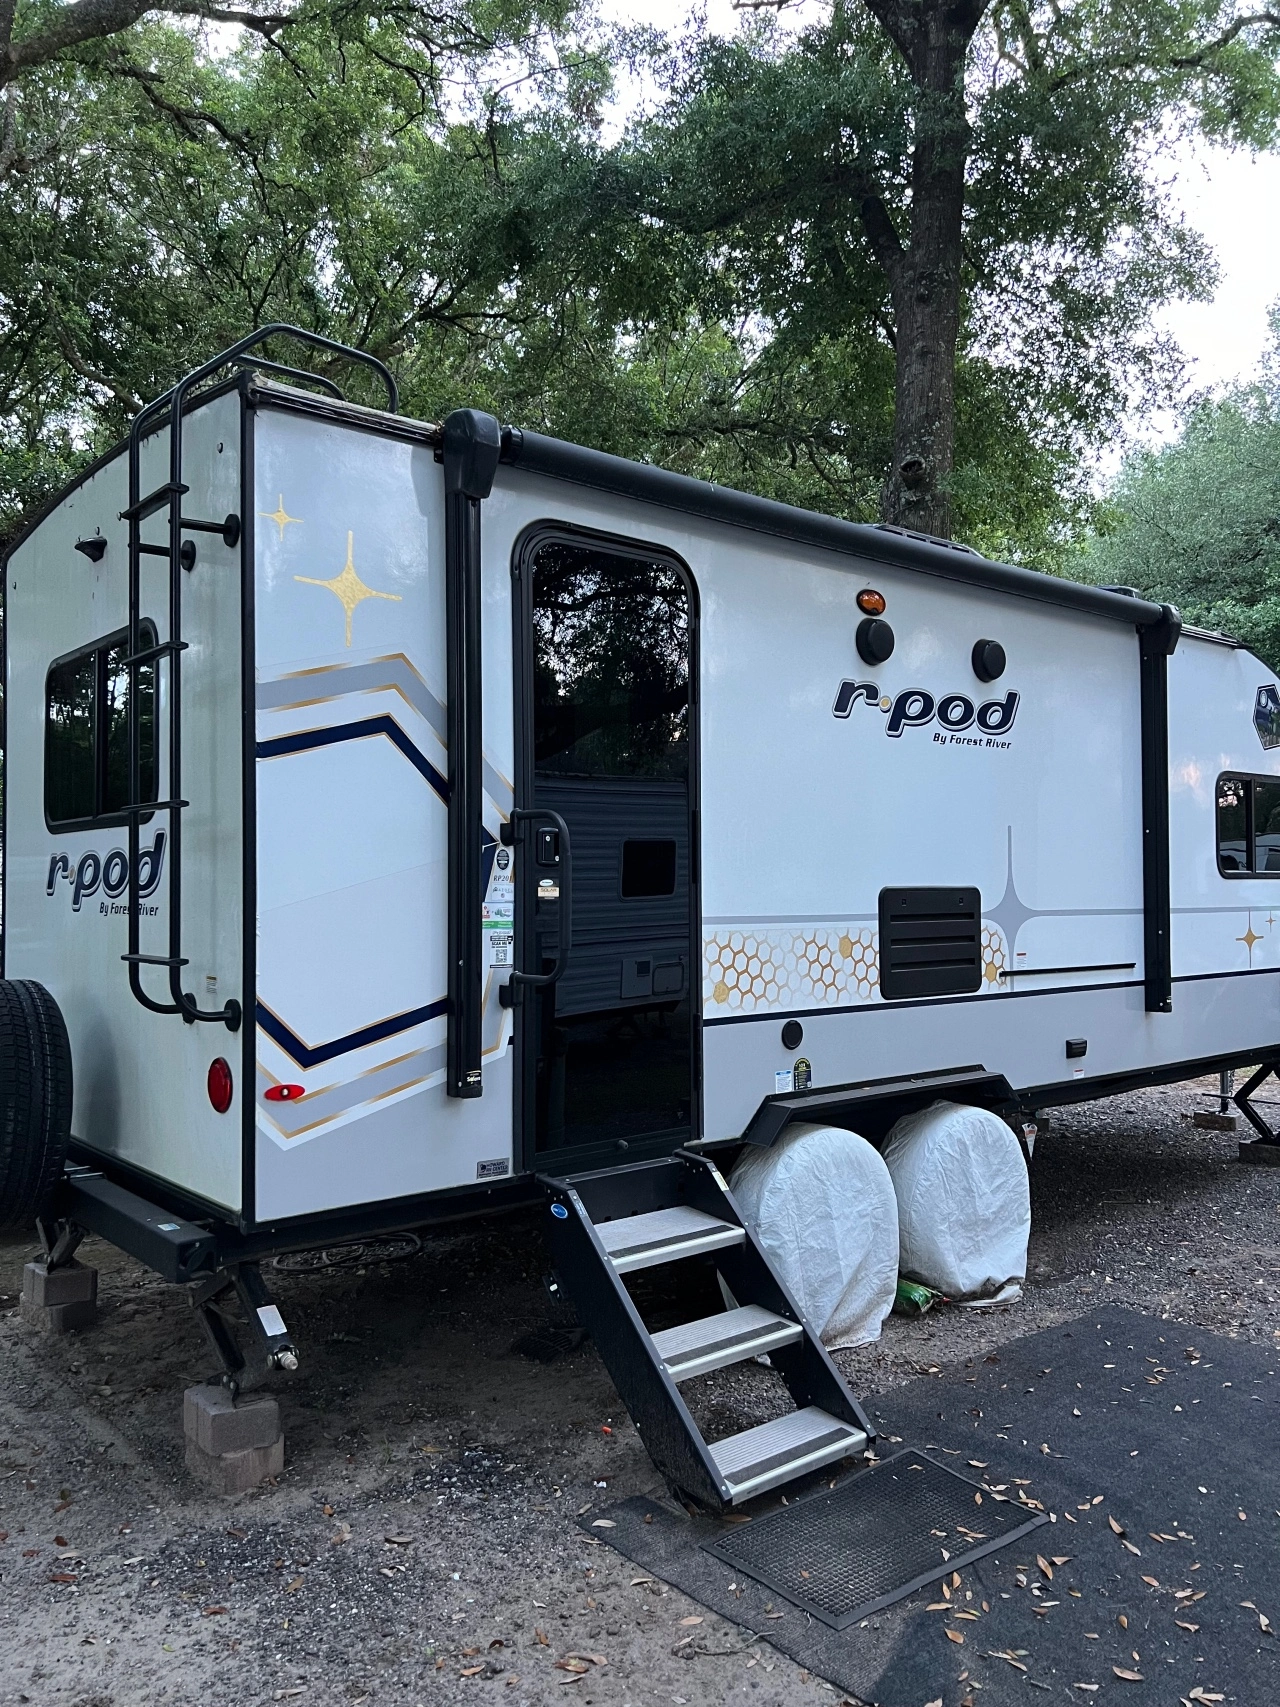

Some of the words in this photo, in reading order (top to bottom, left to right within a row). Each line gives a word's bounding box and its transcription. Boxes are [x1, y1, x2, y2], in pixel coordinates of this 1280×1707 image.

[932, 732, 947, 745] By
[949, 734, 983, 747] Forest
[985, 738, 1012, 749] River
[99, 901, 109, 916] By
[110, 902, 130, 915] Fores
